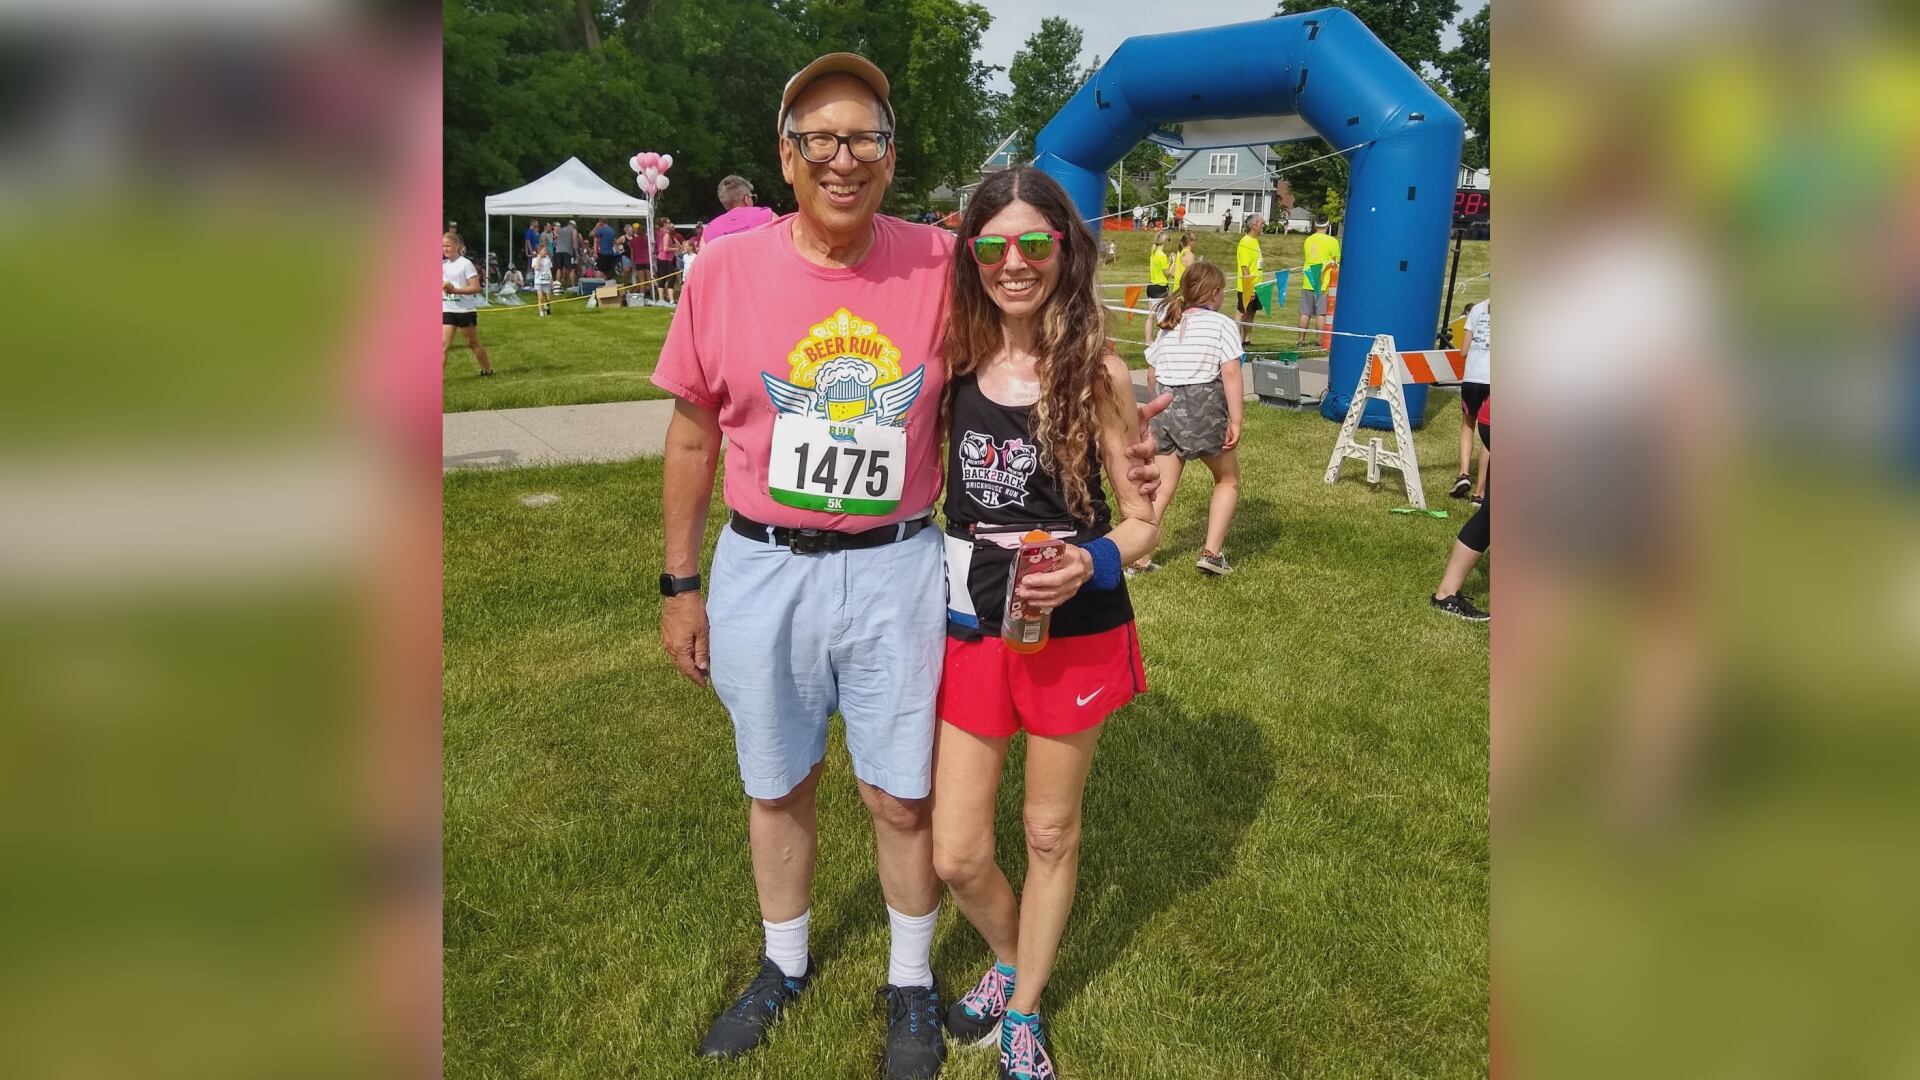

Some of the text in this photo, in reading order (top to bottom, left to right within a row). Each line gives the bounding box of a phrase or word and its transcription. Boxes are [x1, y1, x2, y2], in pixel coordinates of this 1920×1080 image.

[804, 336, 883, 363] BEER RUN
[794, 443, 889, 497] 1475
[964, 469, 1024, 488] BACK2BACK
[966, 481, 1019, 498] BRICKHOUSE RUN
[982, 490, 1000, 505] 5K
[828, 498, 843, 509] 5K
